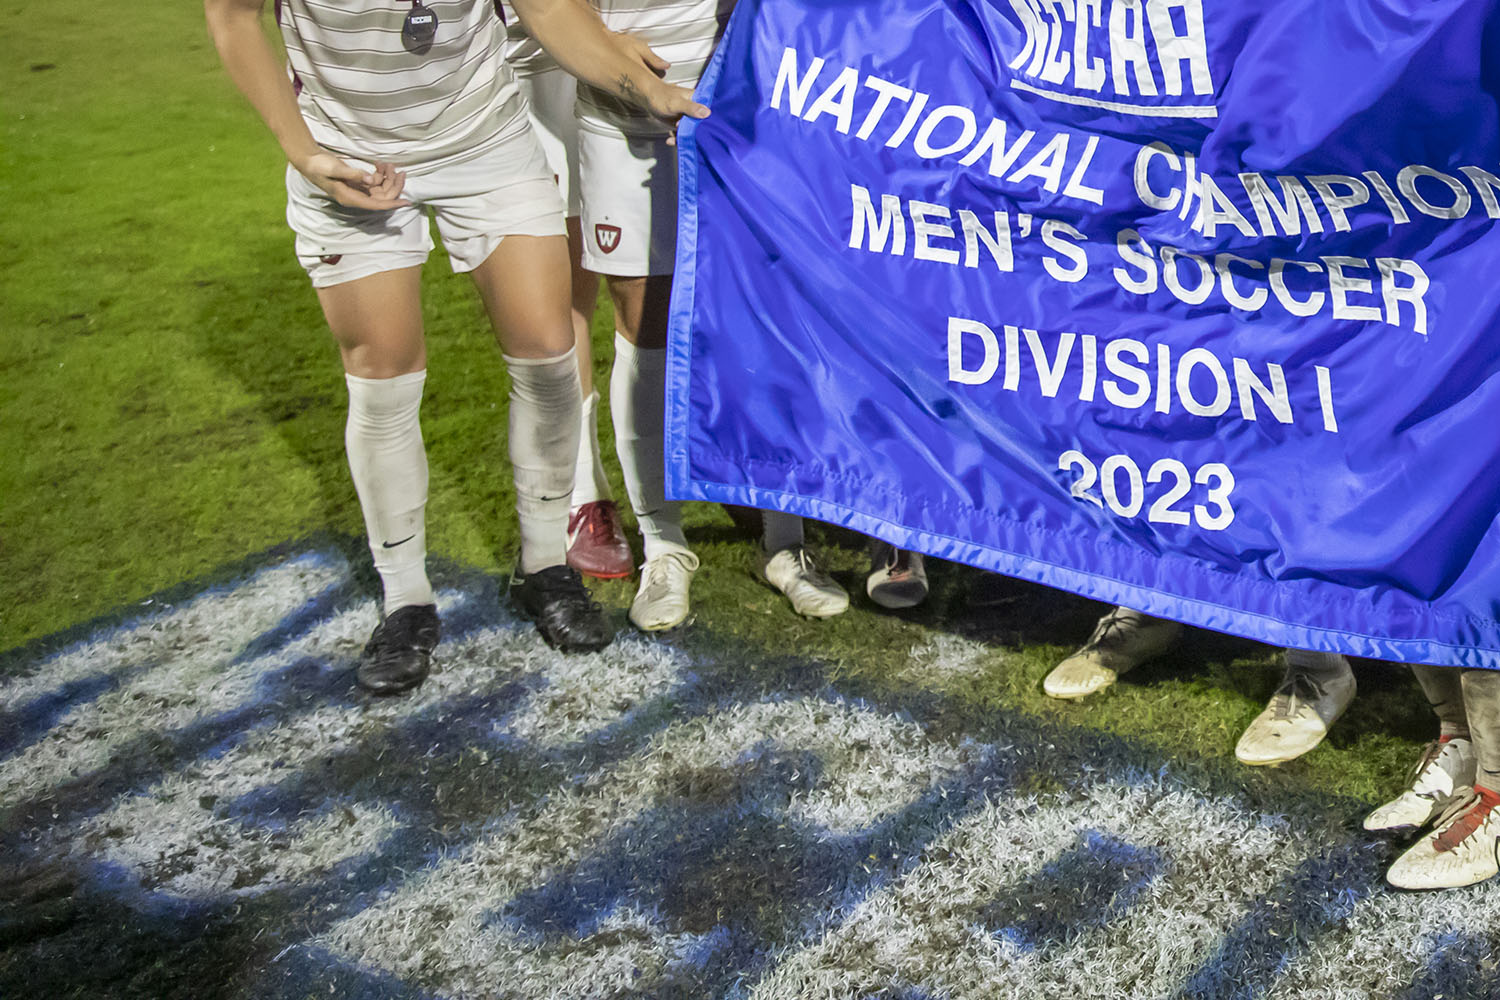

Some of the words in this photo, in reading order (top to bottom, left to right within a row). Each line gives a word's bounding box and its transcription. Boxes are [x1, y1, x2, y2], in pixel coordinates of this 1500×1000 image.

[770, 47, 1105, 206] NATIONAL
[597, 229, 618, 248] W
[848, 184, 1089, 283] MEN'S
[1112, 229, 1430, 336] SOCCER
[947, 316, 1294, 424] DIVISION
[1314, 365, 1339, 433] I
[1058, 449, 1236, 532] 2023
